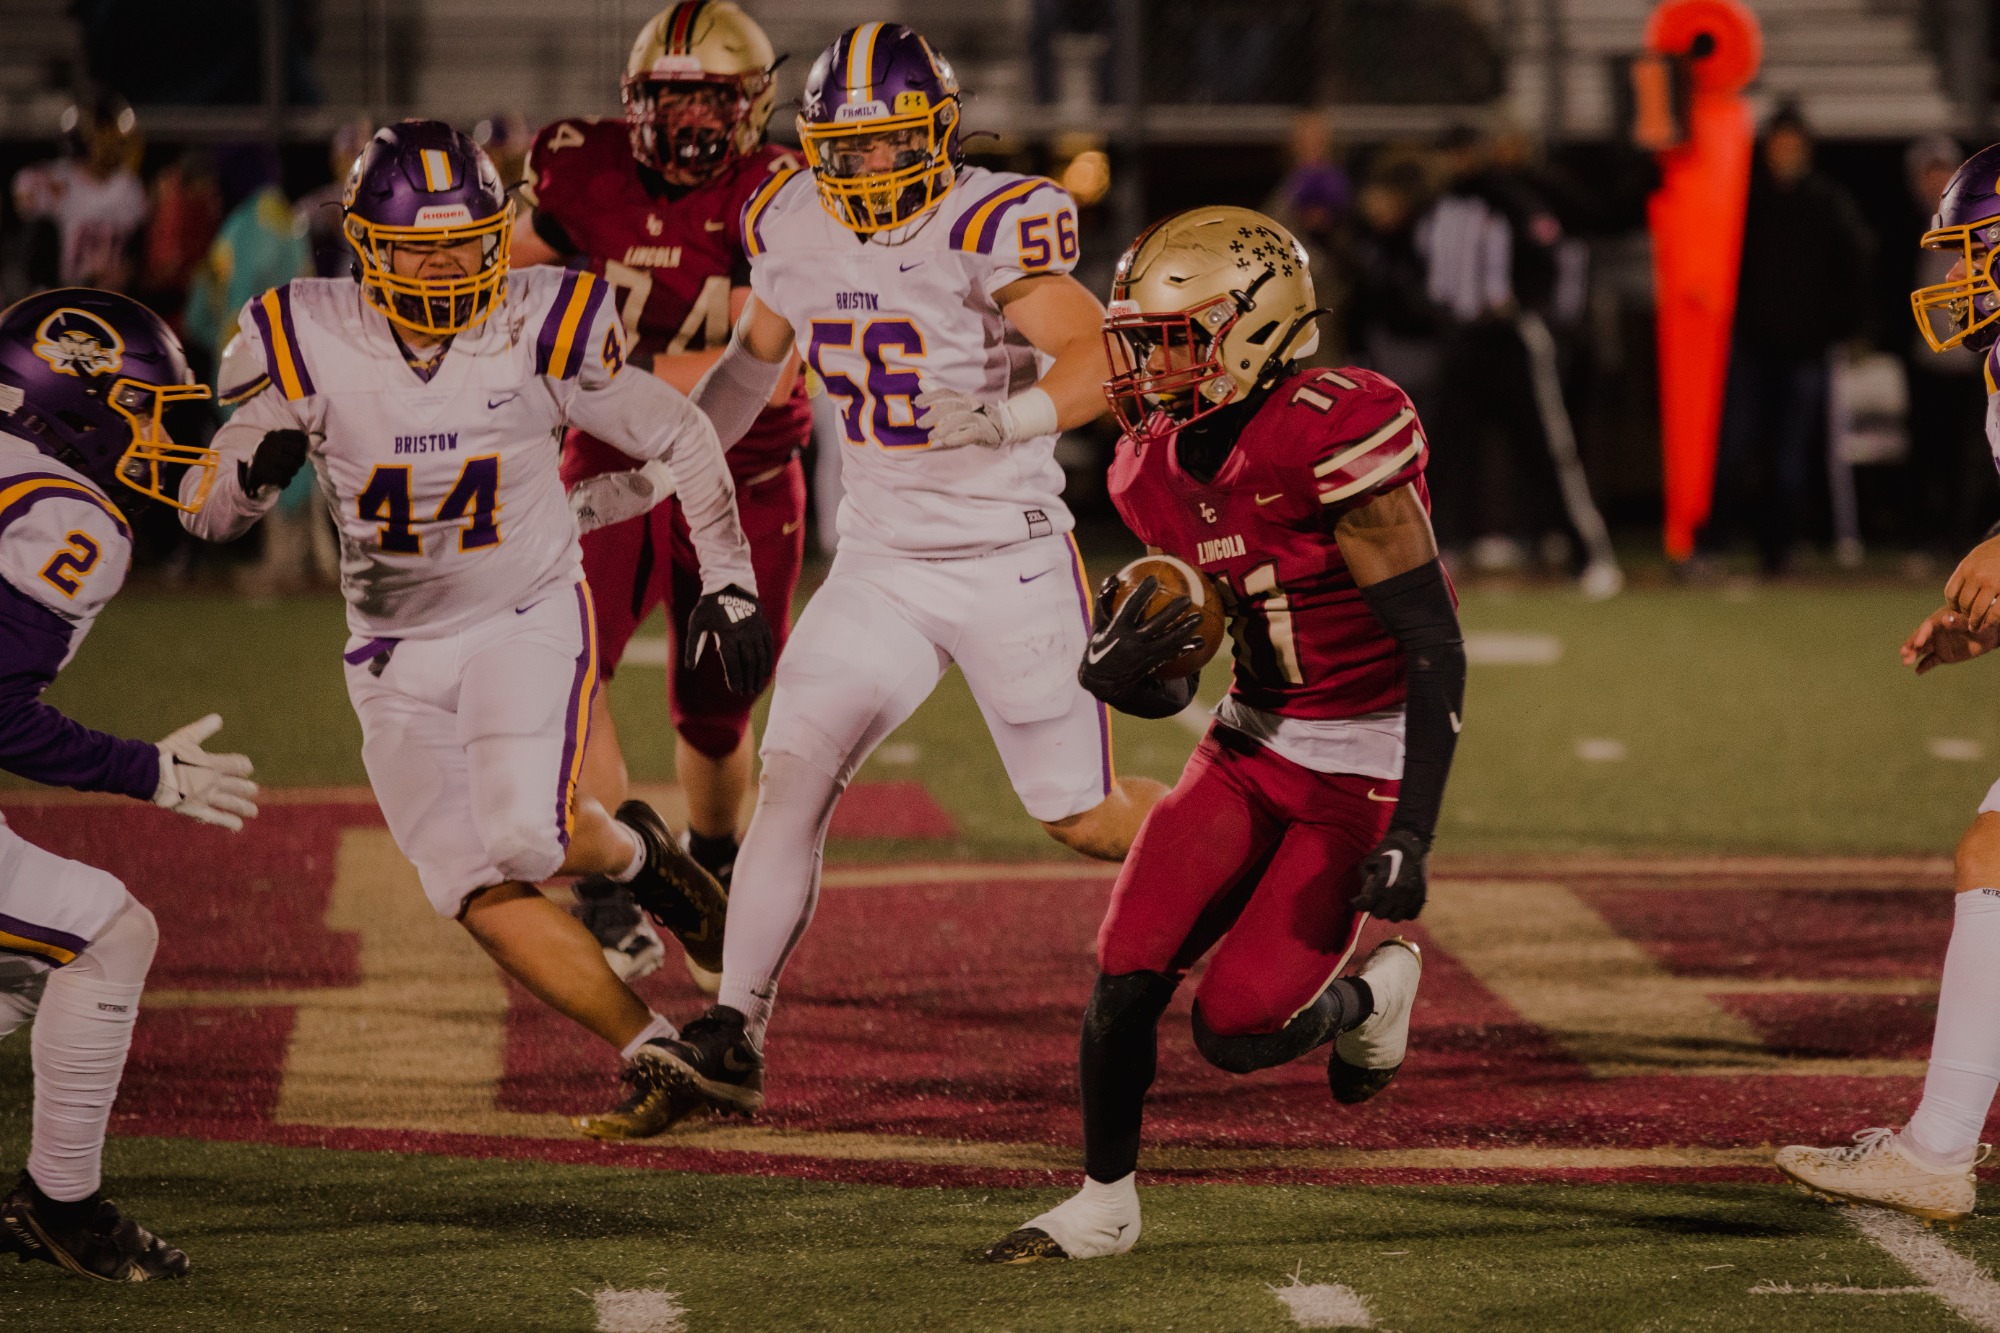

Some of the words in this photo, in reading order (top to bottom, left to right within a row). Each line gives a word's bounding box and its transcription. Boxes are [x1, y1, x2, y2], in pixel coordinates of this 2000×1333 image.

[843, 106, 878, 117] FAMILY
[623, 245, 682, 268] LINCOLN
[1018, 207, 1078, 272] 56
[836, 292, 879, 310] BRISTOW
[808, 318, 935, 450] 56
[1289, 370, 1361, 414] 11
[394, 432, 458, 454] BRISTOW
[356, 452, 504, 557] 44
[1199, 502, 1217, 524] LC
[39, 530, 101, 600] 2
[1197, 533, 1247, 564] LINCOLN
[1216, 559, 1304, 686] 11
